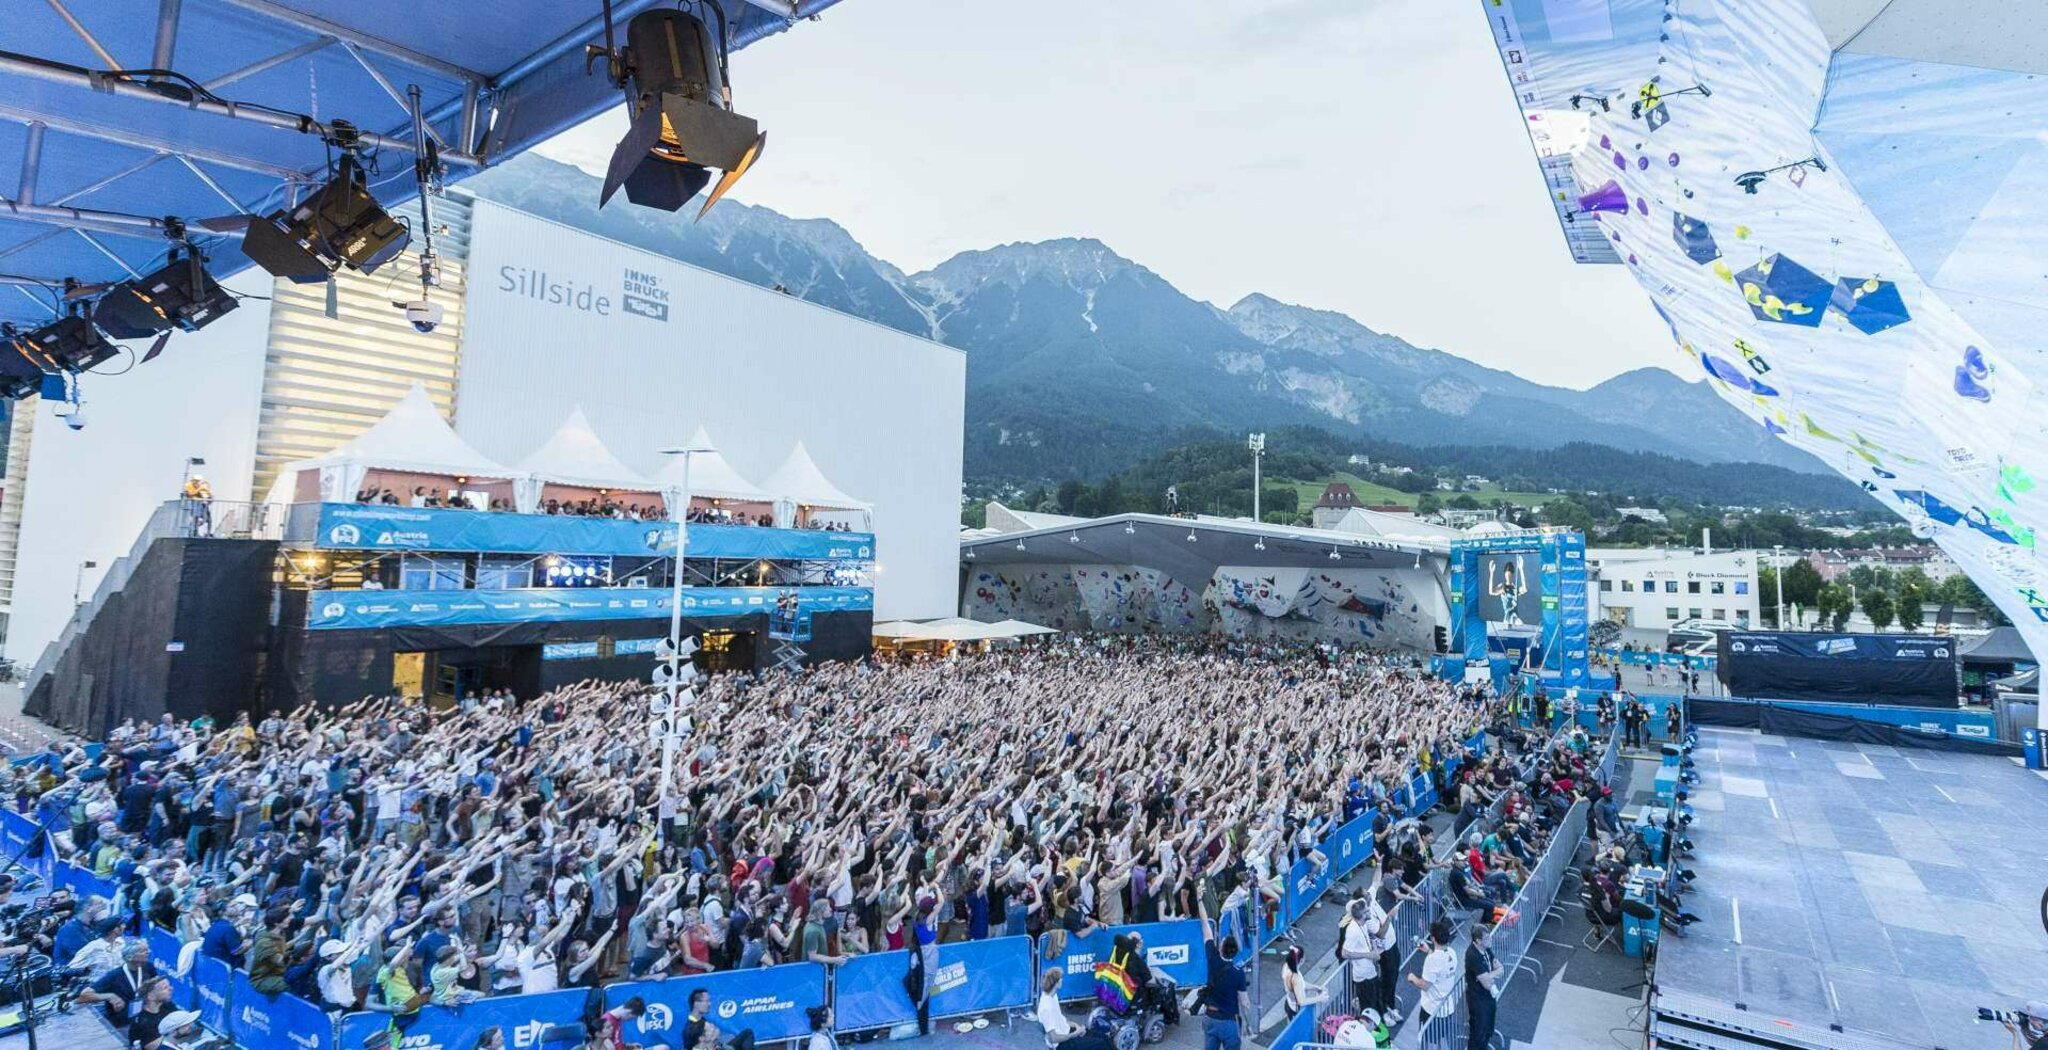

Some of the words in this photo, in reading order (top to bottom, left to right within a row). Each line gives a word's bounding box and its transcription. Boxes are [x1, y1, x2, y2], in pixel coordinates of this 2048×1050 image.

[499, 265, 611, 317] Sillside
[624, 279, 670, 302] BRUCK
[1152, 949, 1184, 961] Tirol
[1067, 961, 1097, 975] BRUC
[741, 996, 777, 1007] JAPAN
[743, 1001, 795, 1014] AIRLINES
